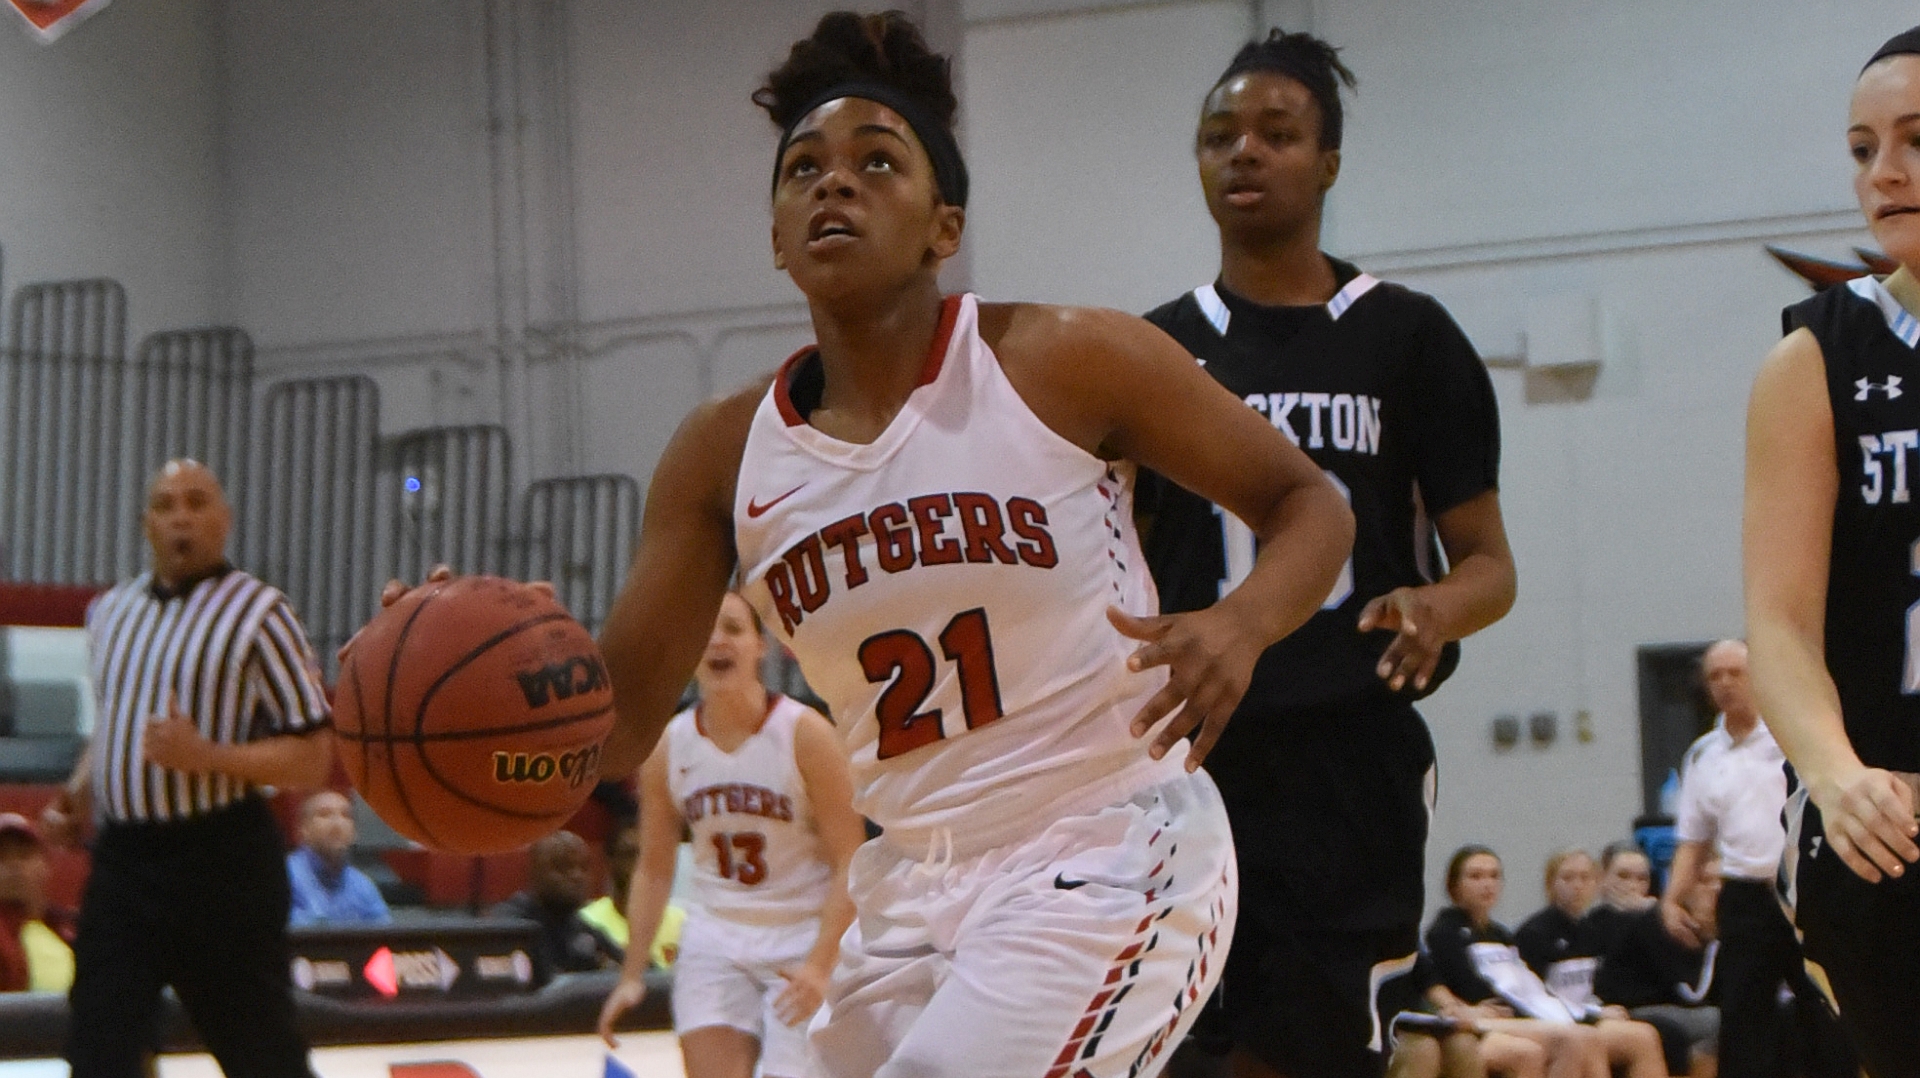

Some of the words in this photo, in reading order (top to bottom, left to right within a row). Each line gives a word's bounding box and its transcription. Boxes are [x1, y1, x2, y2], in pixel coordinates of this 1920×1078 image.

[764, 492, 1058, 637] RUTGERS
[857, 606, 1004, 760] 21
[684, 782, 794, 824] UTGERS
[710, 832, 770, 886] 13
